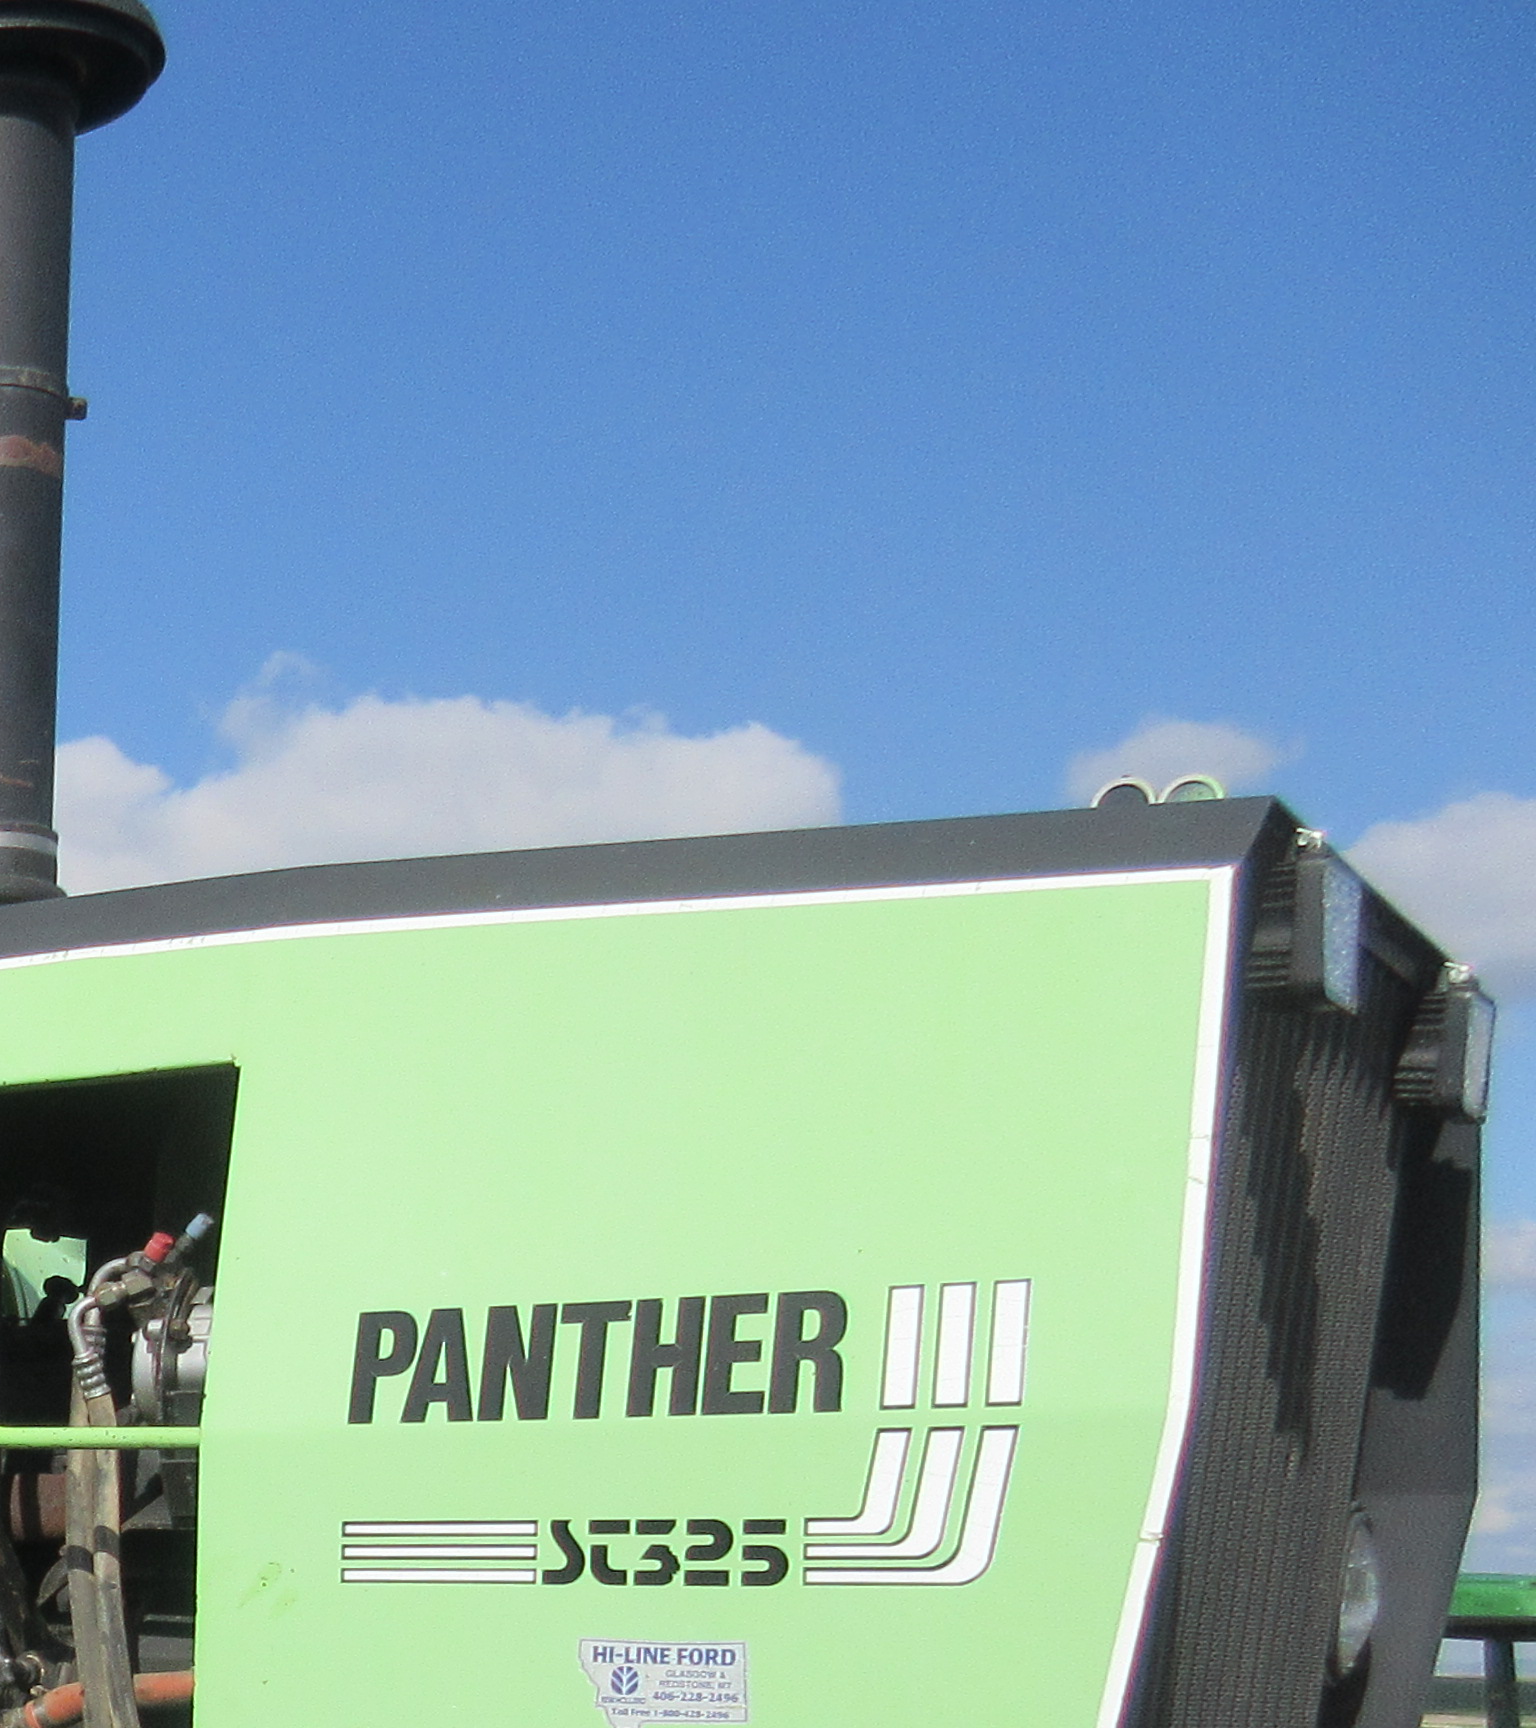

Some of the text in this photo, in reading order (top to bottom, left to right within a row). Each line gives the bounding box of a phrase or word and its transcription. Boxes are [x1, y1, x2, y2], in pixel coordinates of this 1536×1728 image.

[346, 1288, 849, 1426] PANTHER
[541, 1518, 789, 1588] ST325
[592, 1646, 737, 1667] HI-LINE FORD
[631, 1708, 650, 1717] Free
